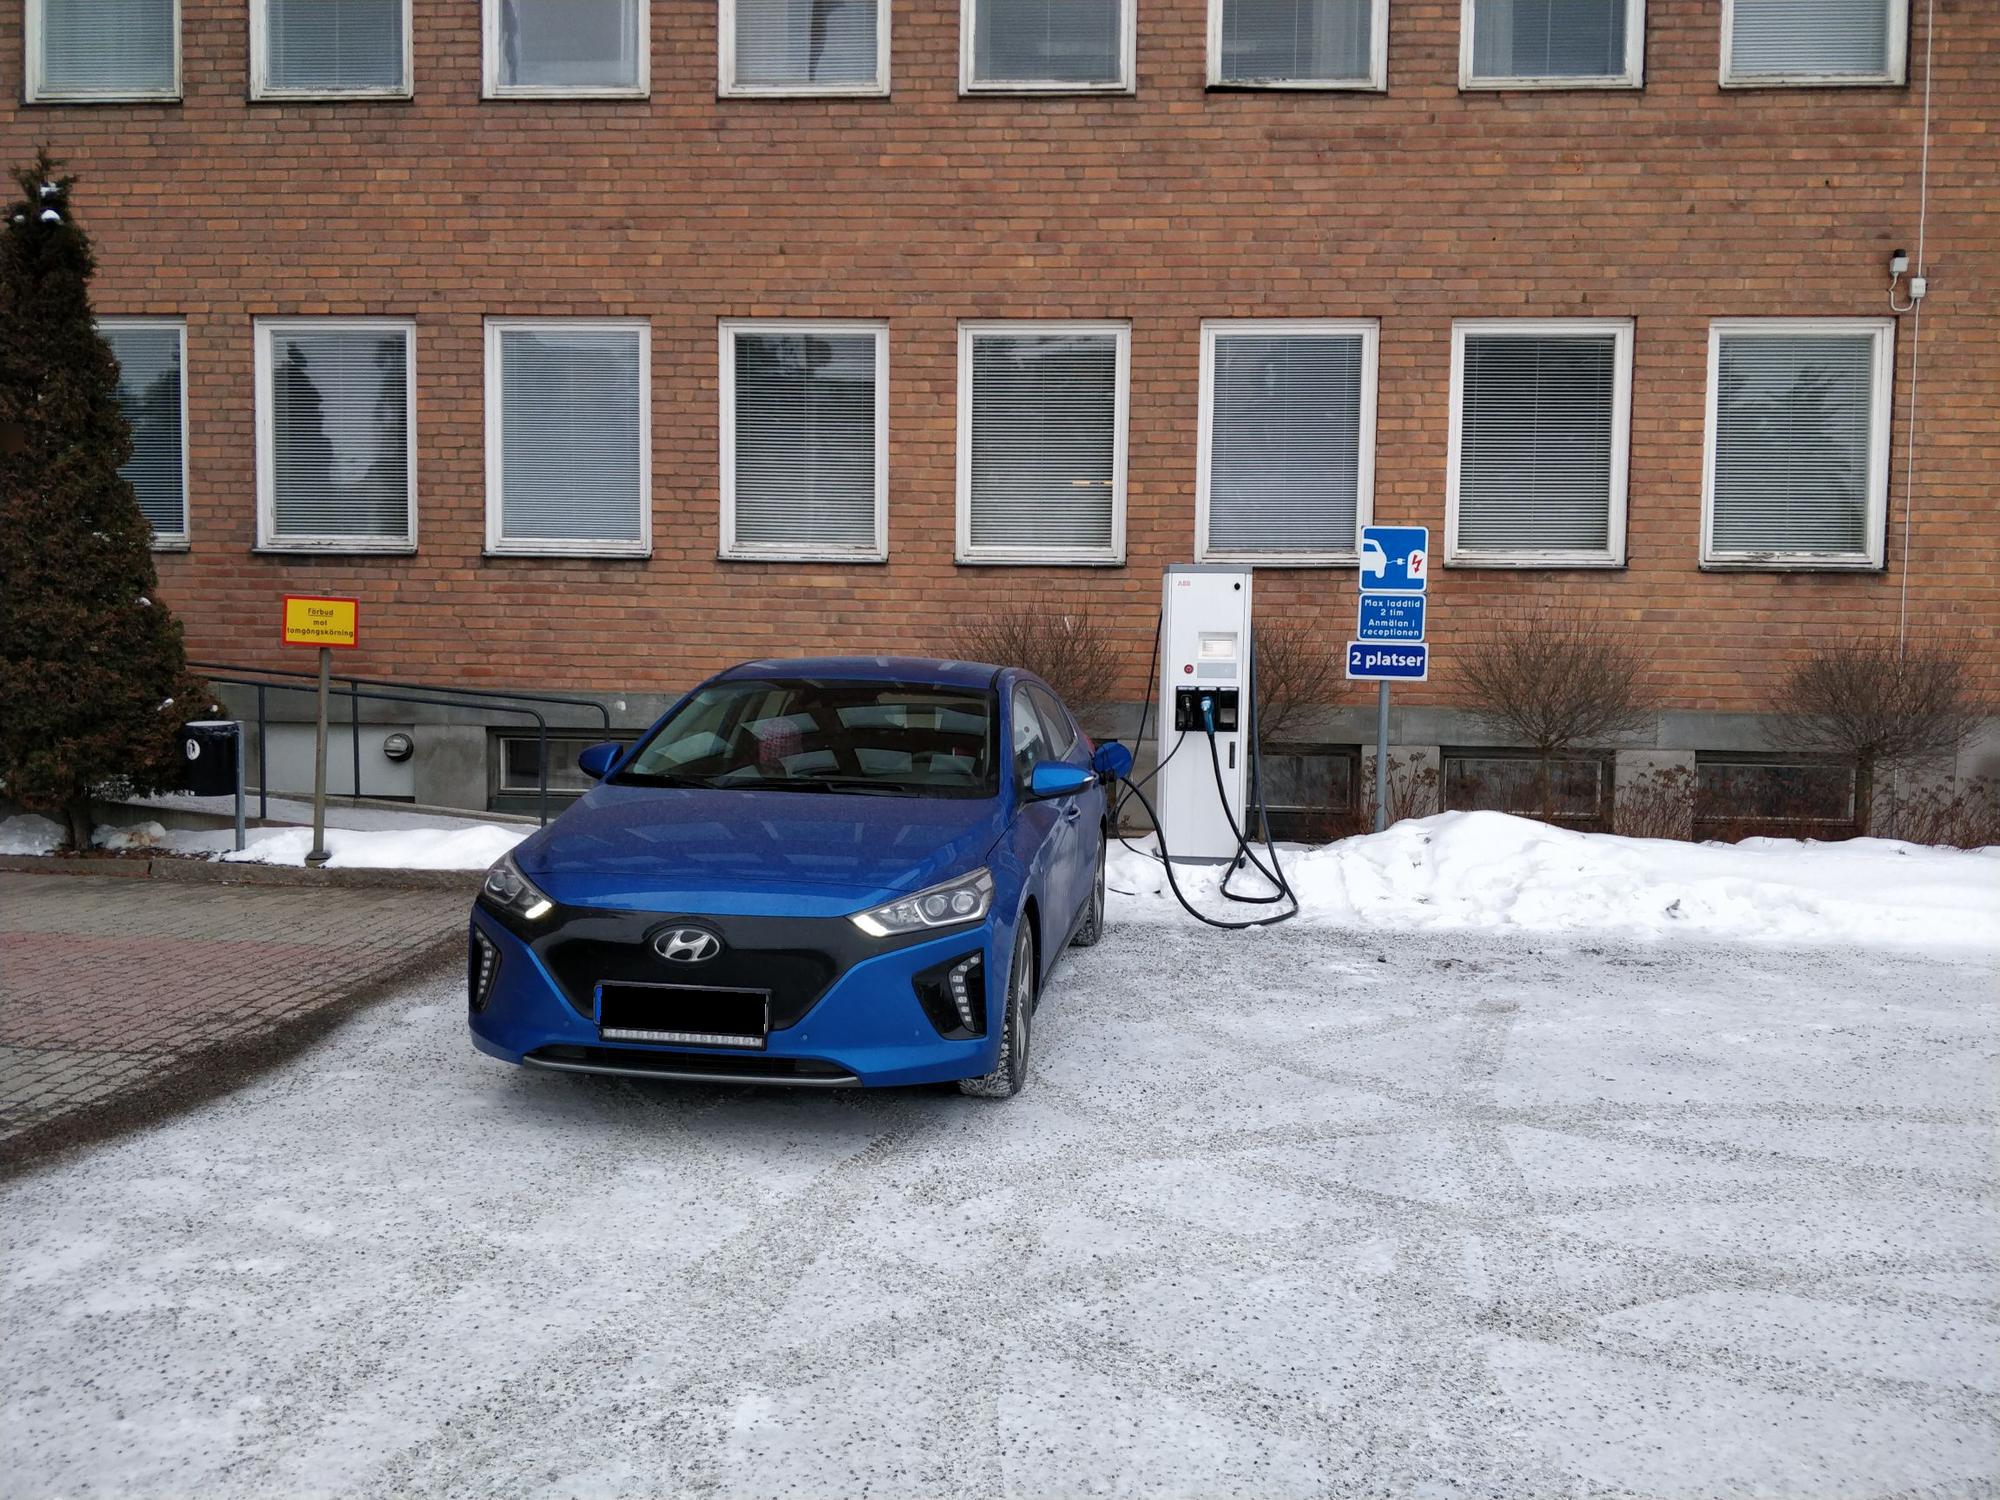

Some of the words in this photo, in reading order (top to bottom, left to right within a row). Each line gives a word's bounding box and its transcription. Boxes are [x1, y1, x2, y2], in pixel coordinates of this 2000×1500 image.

[1365, 599, 1383, 607] Max
[1387, 600, 1420, 608] laddtid
[307, 608, 334, 616] Förbud
[1368, 618, 1408, 627] Anmälan
[287, 627, 354, 638] tomgångskörning
[1363, 628, 1419, 636] receptionen
[1351, 651, 1361, 665] 2
[1365, 651, 1424, 669] platser
